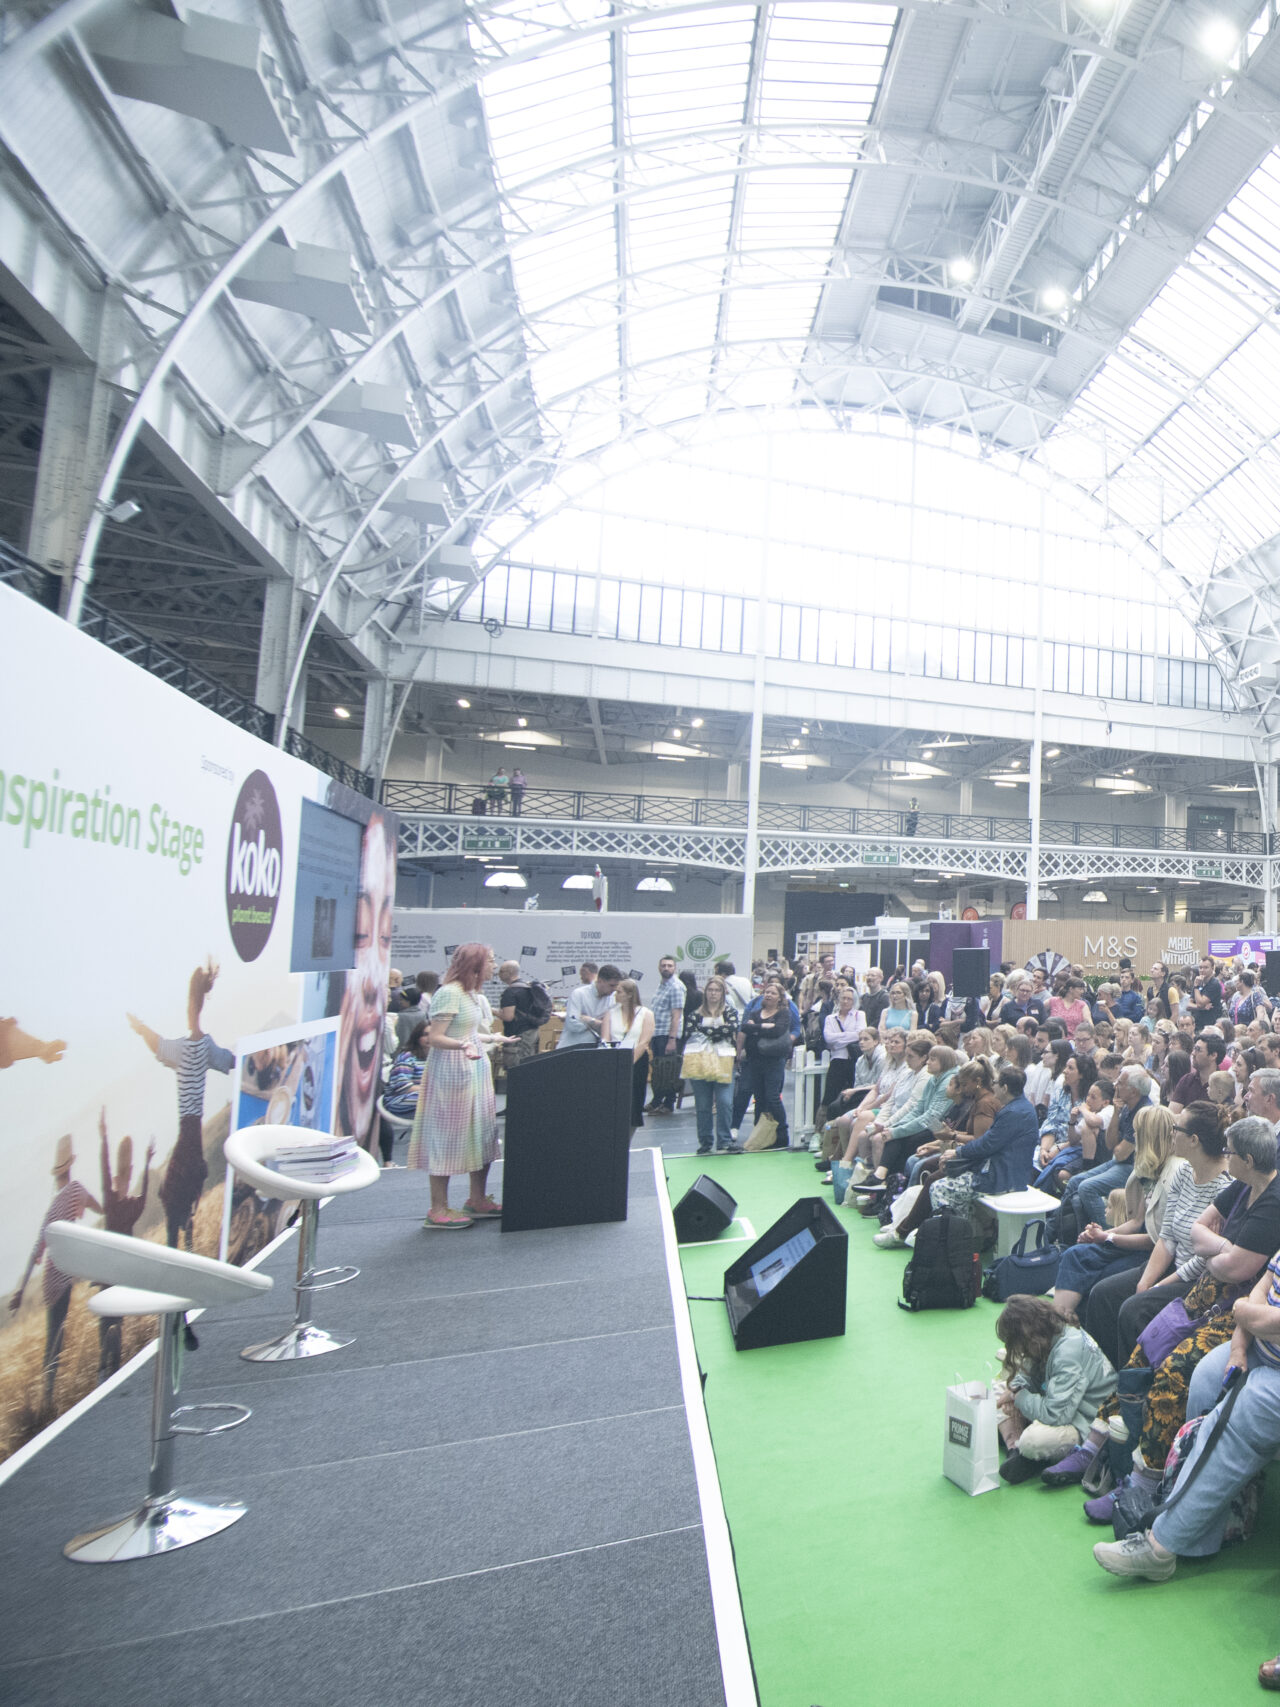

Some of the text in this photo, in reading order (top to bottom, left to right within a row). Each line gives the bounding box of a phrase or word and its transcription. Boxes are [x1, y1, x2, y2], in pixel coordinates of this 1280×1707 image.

[0, 767, 205, 876] spiration Stage
[230, 822, 281, 898] koko
[1084, 935, 1138, 958] M&S
[1167, 936, 1193, 950] MADE
[1096, 961, 1120, 970] FOO
[1161, 949, 1200, 965] WITHOUT
